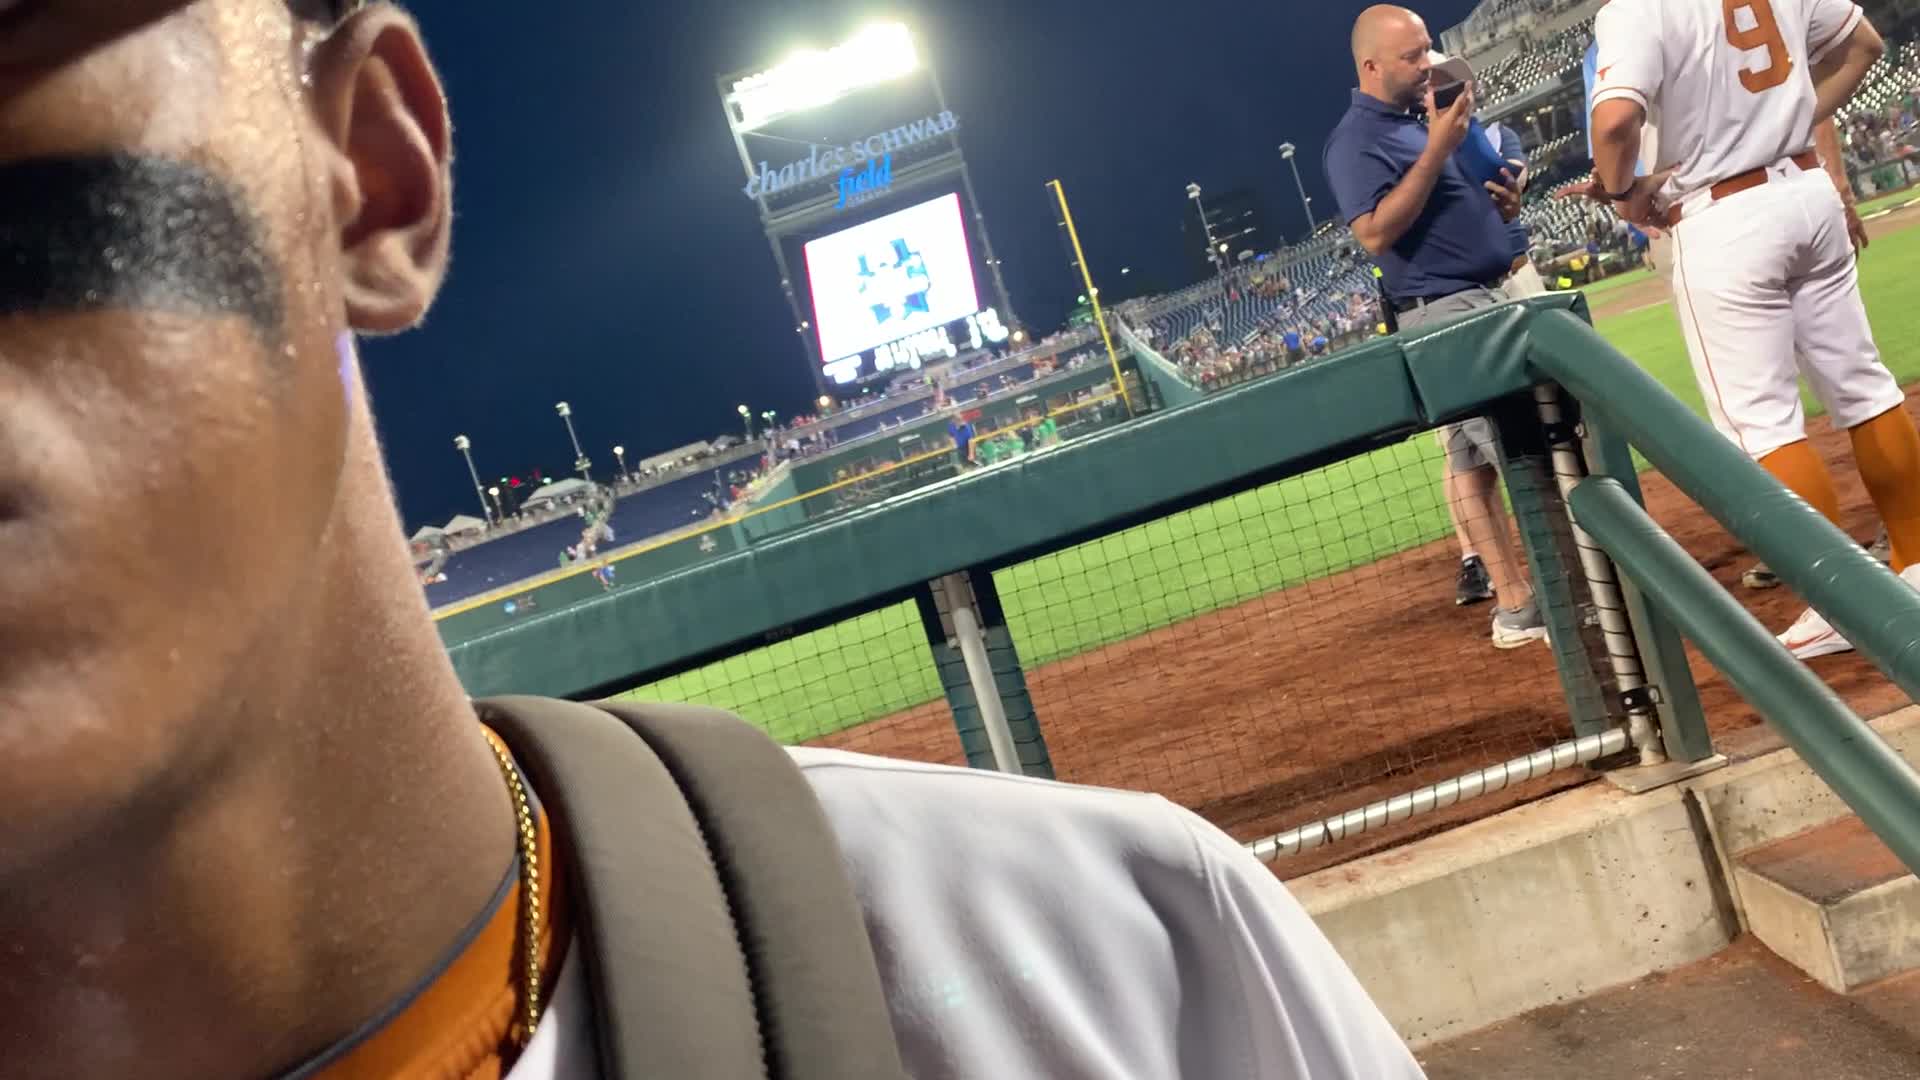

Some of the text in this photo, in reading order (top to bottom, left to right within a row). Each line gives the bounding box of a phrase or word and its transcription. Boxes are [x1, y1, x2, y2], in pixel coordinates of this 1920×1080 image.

[1721, 0, 1793, 94] 9
[744, 110, 959, 200] charles SCHWAB
[833, 152, 893, 210] field
